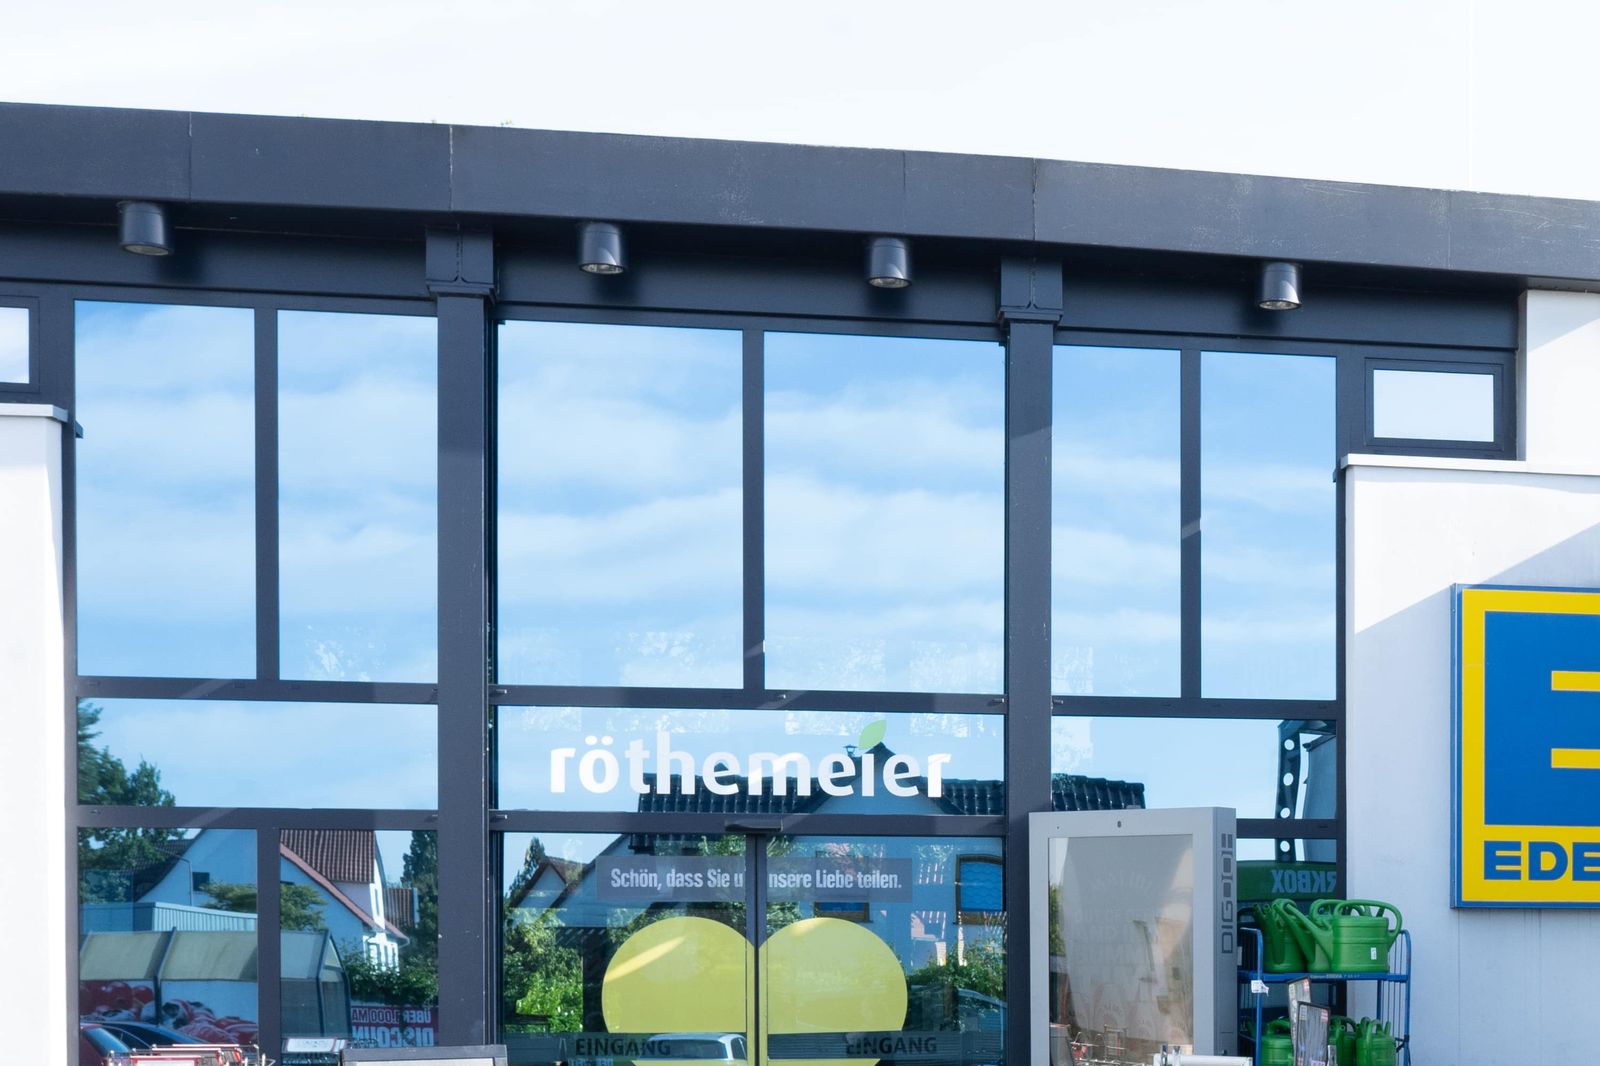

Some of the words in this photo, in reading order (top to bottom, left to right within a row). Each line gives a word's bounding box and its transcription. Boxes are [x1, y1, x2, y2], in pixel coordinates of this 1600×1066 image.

[550, 721, 952, 798] röthemeier
[611, 867, 662, 890] Schön,
[666, 868, 703, 888] dass
[707, 868, 730, 888] Sie
[816, 869, 853, 889] Liebe
[857, 869, 902, 889] teilen.
[575, 1037, 671, 1056] EINGANG
[845, 1037, 938, 1055] EINGANG
